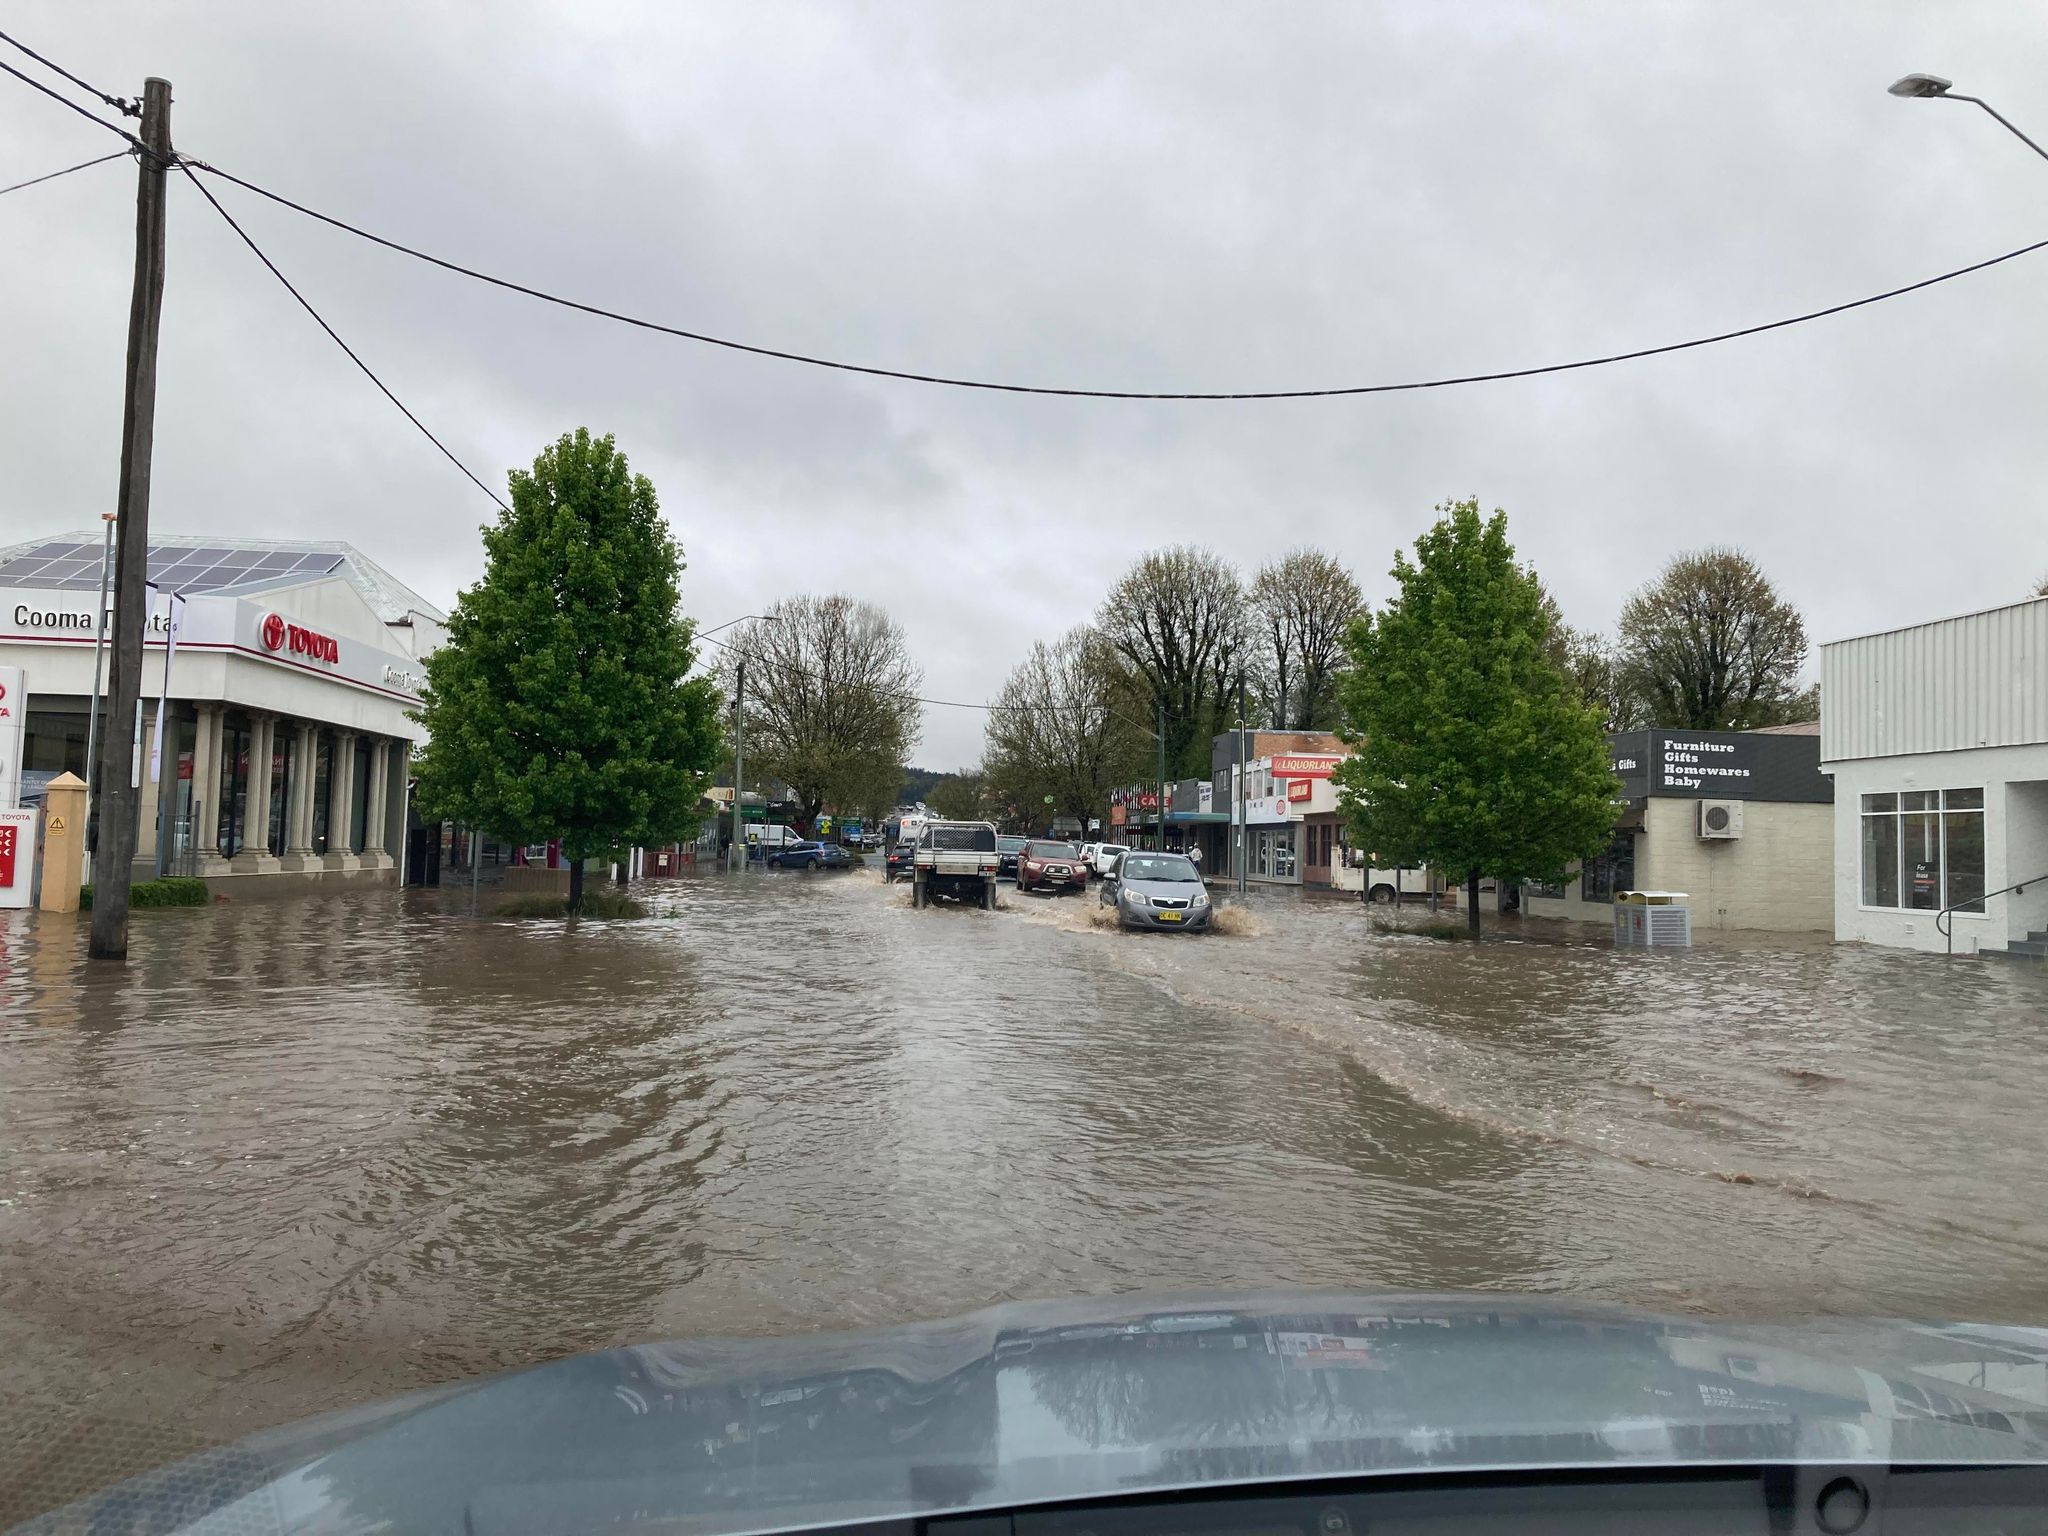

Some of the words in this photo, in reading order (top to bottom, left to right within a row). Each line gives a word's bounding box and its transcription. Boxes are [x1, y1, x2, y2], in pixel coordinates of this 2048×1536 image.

[14, 605, 92, 629] Cooma
[288, 624, 339, 664] TOYOTA
[1664, 740, 1735, 753] Furniture
[1664, 752, 1699, 763] Gifts
[1618, 759, 1637, 770] Gifts
[1664, 764, 1750, 777] Homewares
[1664, 776, 1702, 789] Baby
